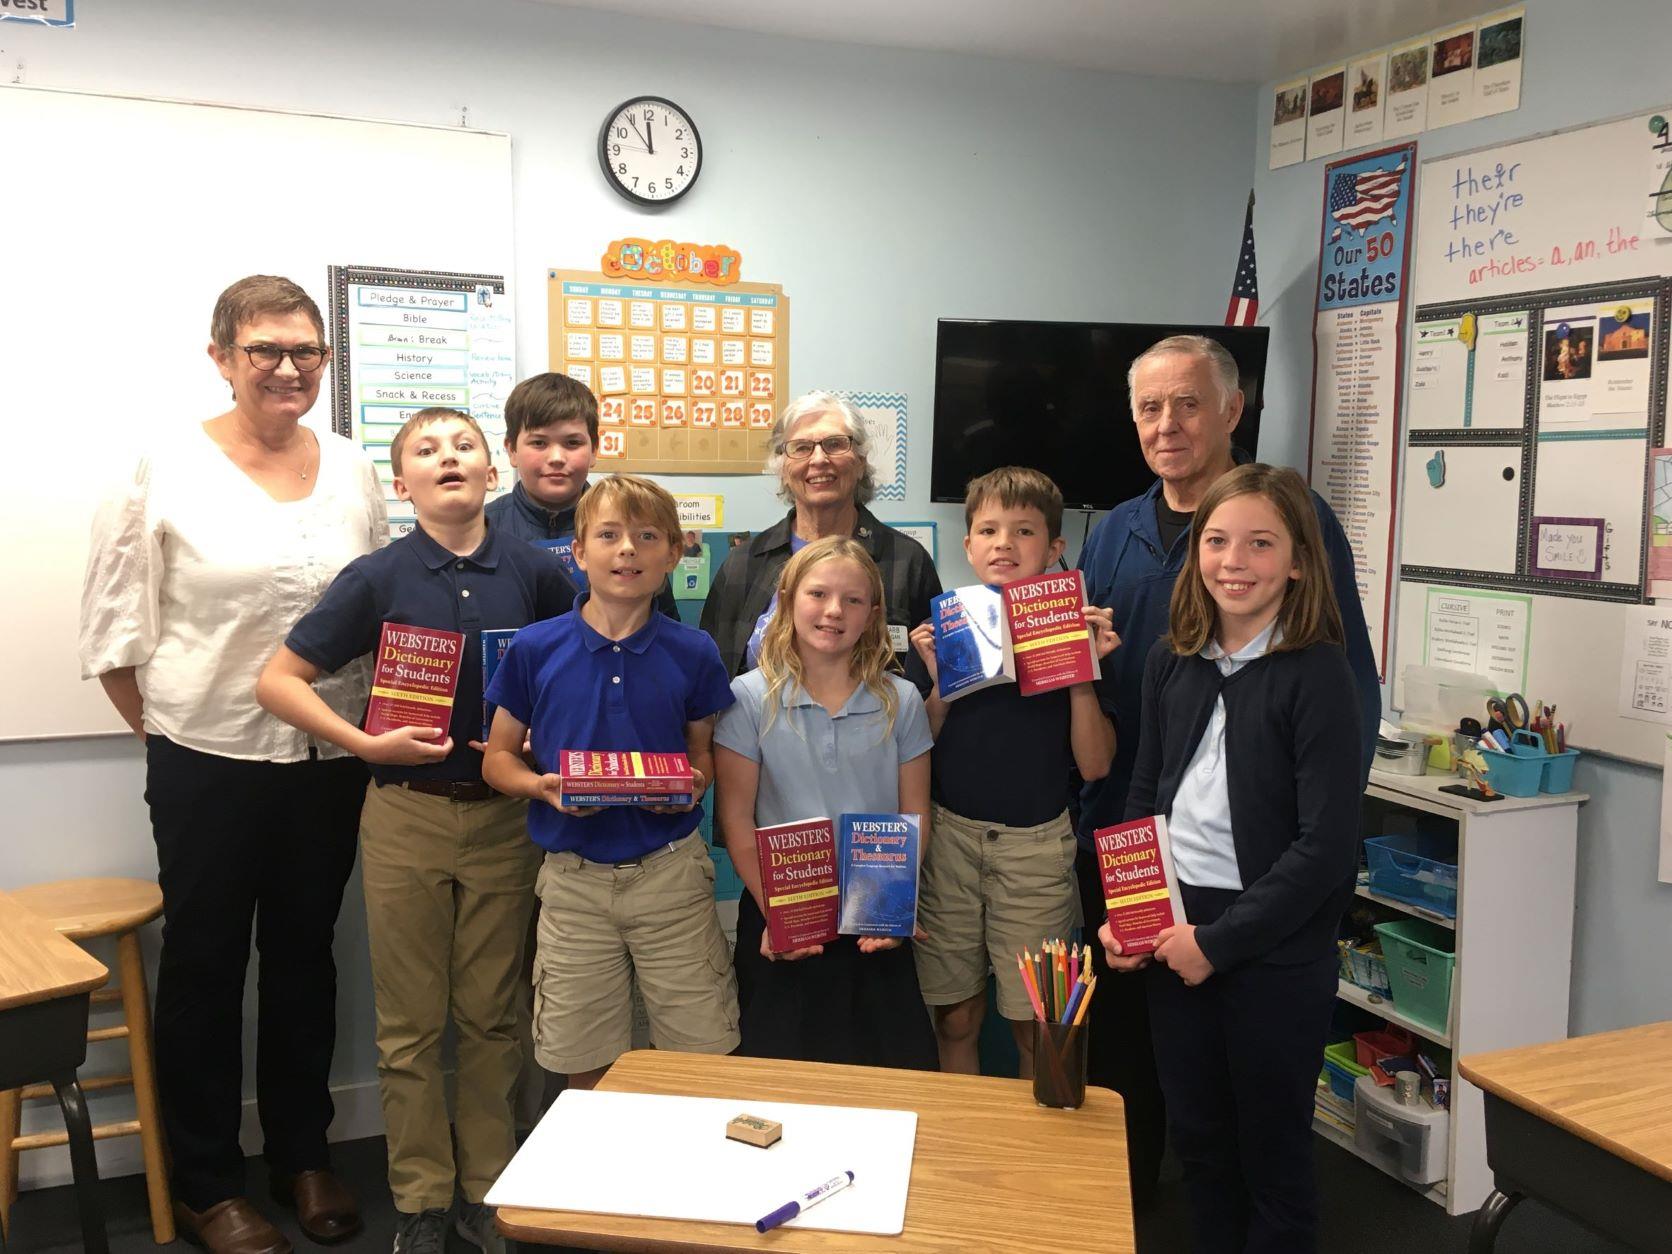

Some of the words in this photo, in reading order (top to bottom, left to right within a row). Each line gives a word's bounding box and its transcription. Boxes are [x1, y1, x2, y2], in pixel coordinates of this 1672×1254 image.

[643, 109, 655, 121] 12
[616, 126, 628, 139] 10
[675, 128, 684, 140] 2
[612, 144, 621, 156] 9
[680, 147, 689, 159] 3
[618, 162, 627, 175] 8
[676, 165, 684, 177] 4
[632, 176, 639, 188] 7
[648, 182, 656, 194] 6
[665, 178, 673, 189] 5
[1449, 192, 1524, 230] they're
[1606, 227, 1641, 254] the
[1334, 245, 1363, 267] Our
[1365, 231, 1395, 263] 50
[619, 242, 736, 279] October
[1323, 267, 1396, 302] States
[370, 292, 405, 306] Pledge
[408, 295, 417, 304] &
[420, 296, 455, 308] Prayer
[632, 289, 653, 298] TUESDAY
[725, 295, 741, 303] FRIDAY
[750, 297, 774, 305] SATURDAY
[403, 313, 428, 323] Bible
[418, 334, 448, 345] Break
[396, 353, 433, 365] History
[394, 371, 432, 380] Science
[694, 375, 714, 391] 20
[725, 375, 739, 391] 21
[752, 376, 771, 392] 22
[375, 389, 405, 399] Snack
[409, 390, 418, 400] &
[421, 390, 456, 401] Recess
[602, 402, 622, 418] 24
[633, 404, 653, 420] 25
[664, 405, 684, 421] 26
[694, 406, 714, 422] 27
[723, 407, 743, 423] 28
[752, 408, 771, 423] 29
[603, 435, 619, 451] 31
[679, 513, 711, 521] ibilities
[1008, 576, 1076, 602] WEBSTER'S
[1011, 596, 1078, 618] Dictionary
[1496, 608, 1515, 617] PRINT
[1014, 620, 1026, 630] for
[1026, 609, 1080, 628] Students
[385, 630, 457, 655] WEBSTER'S
[383, 646, 455, 673] Dictionary
[381, 664, 394, 674] for
[395, 664, 451, 684] Students
[852, 821, 908, 833] WEBSTER'S
[768, 827, 831, 851] WEBSTER'S
[851, 832, 907, 848] Dictionary
[1098, 825, 1154, 853] WEBSTER'S
[851, 848, 907, 862] Thesaurus
[875, 844, 882, 852] &
[770, 848, 832, 867] Dictionary
[1102, 848, 1157, 869] Dictionary
[773, 870, 785, 881] for
[786, 864, 833, 881] Students
[1105, 872, 1116, 883] for
[1115, 864, 1160, 883] Students
